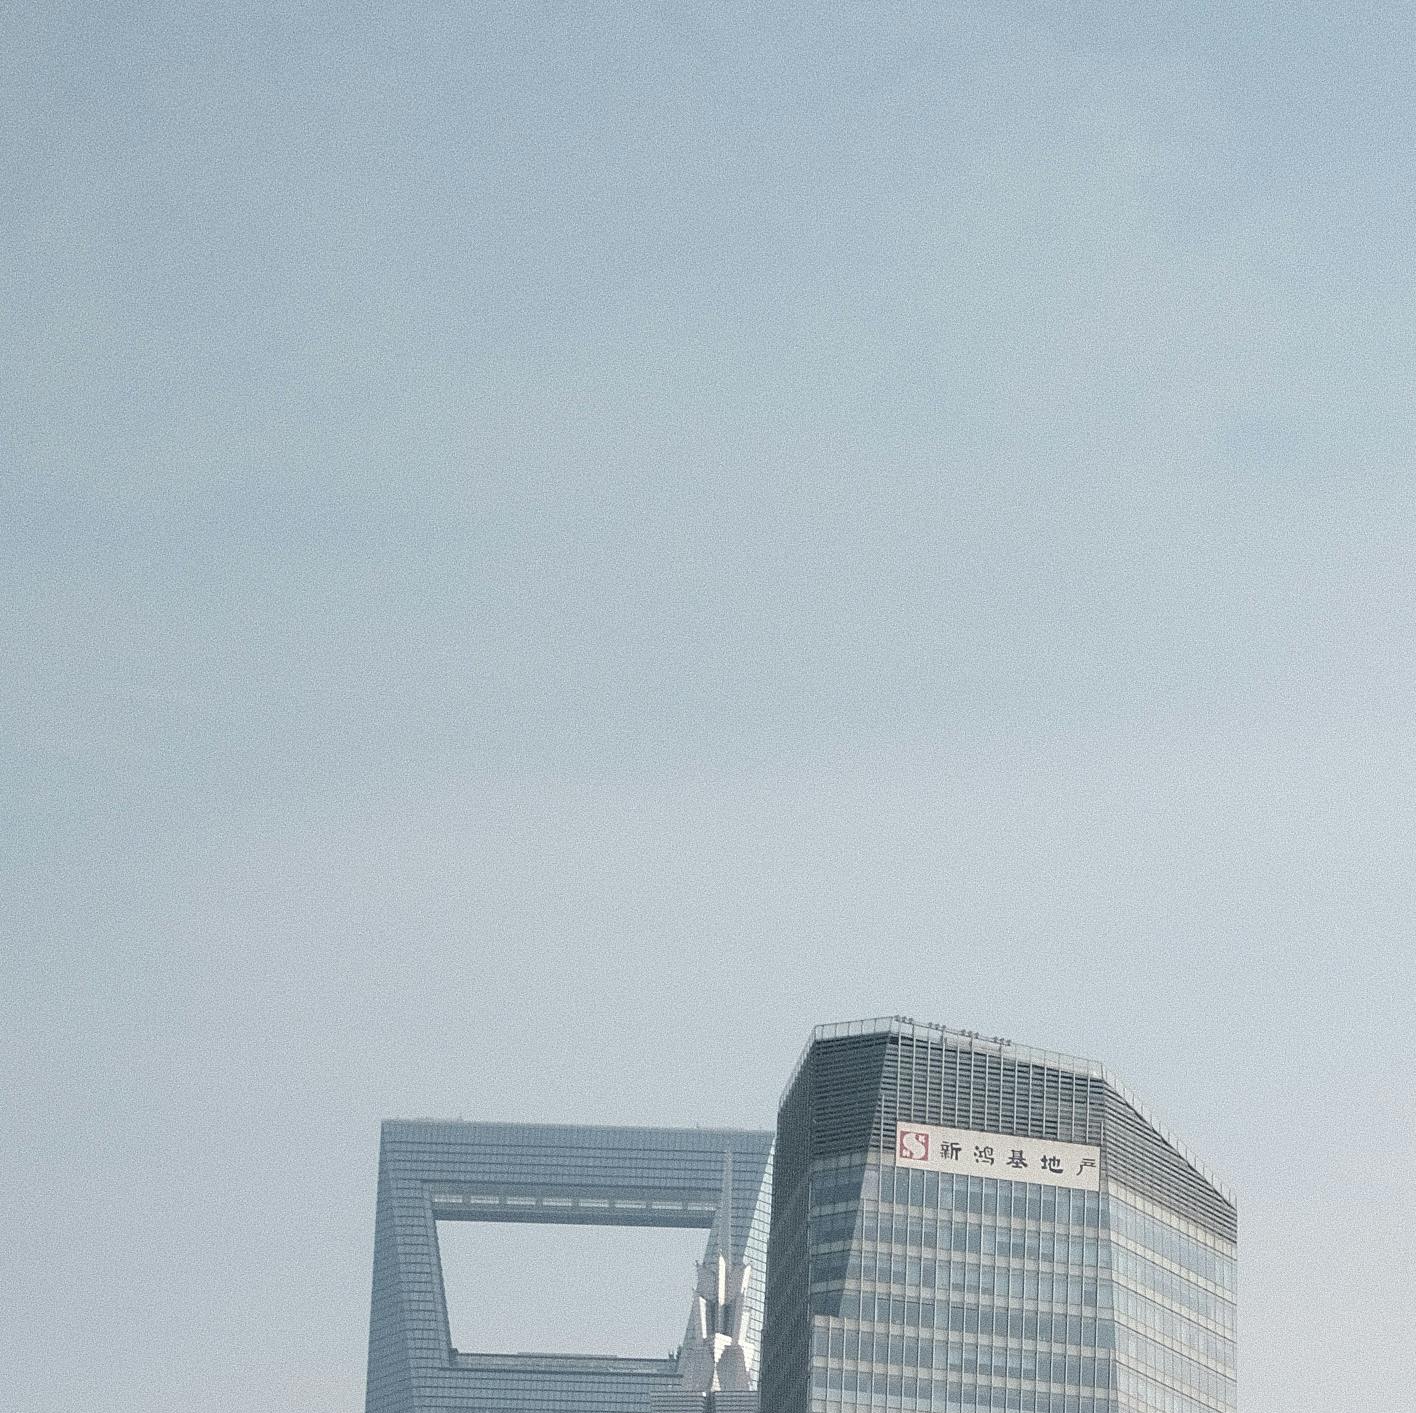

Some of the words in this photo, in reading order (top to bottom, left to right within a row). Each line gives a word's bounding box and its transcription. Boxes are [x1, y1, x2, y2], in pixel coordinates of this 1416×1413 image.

[940, 1140, 1097, 1176] 新鸿基地产
